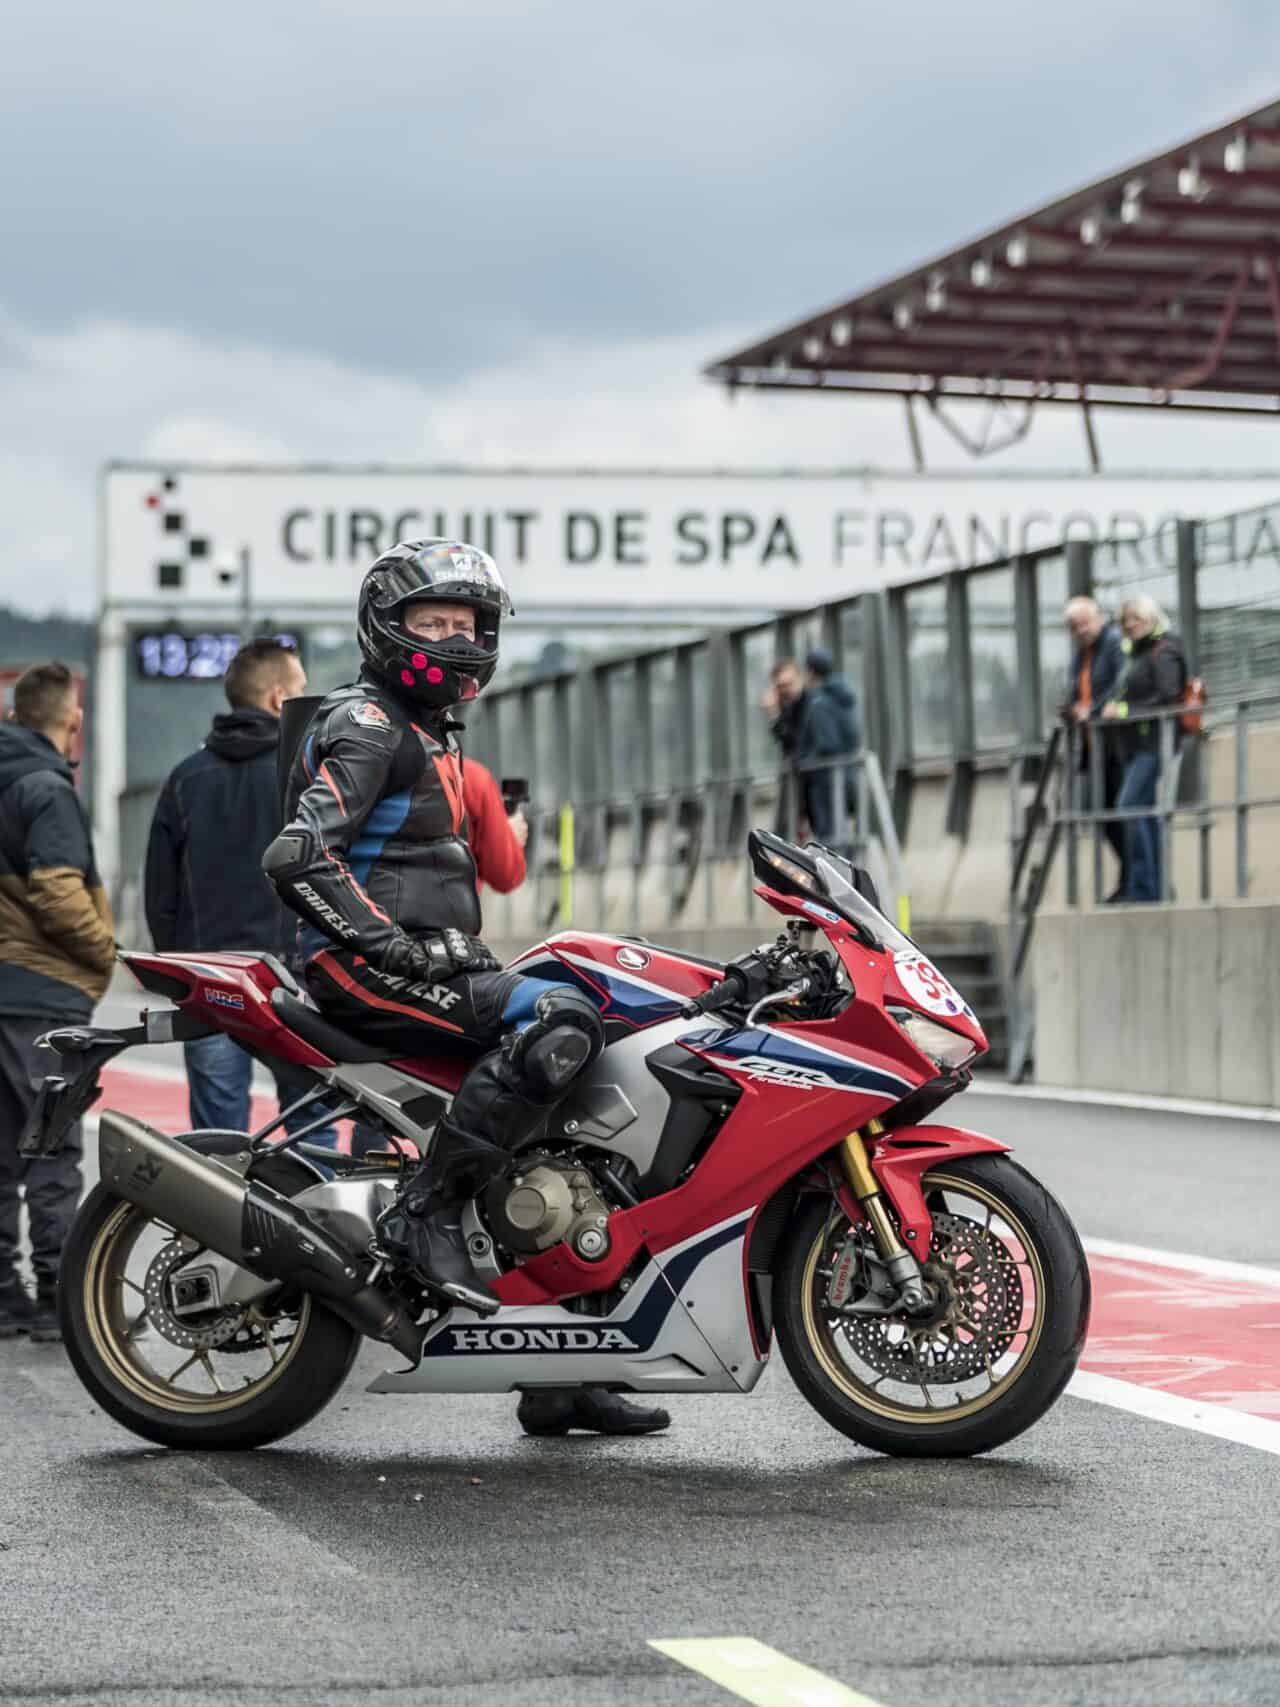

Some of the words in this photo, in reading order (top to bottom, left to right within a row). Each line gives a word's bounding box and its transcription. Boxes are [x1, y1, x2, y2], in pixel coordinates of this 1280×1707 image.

[280, 507, 540, 563] CIRCUIT
[565, 510, 645, 565] DE
[675, 510, 799, 566] SPA
[450, 1328, 639, 1350] HONDA
